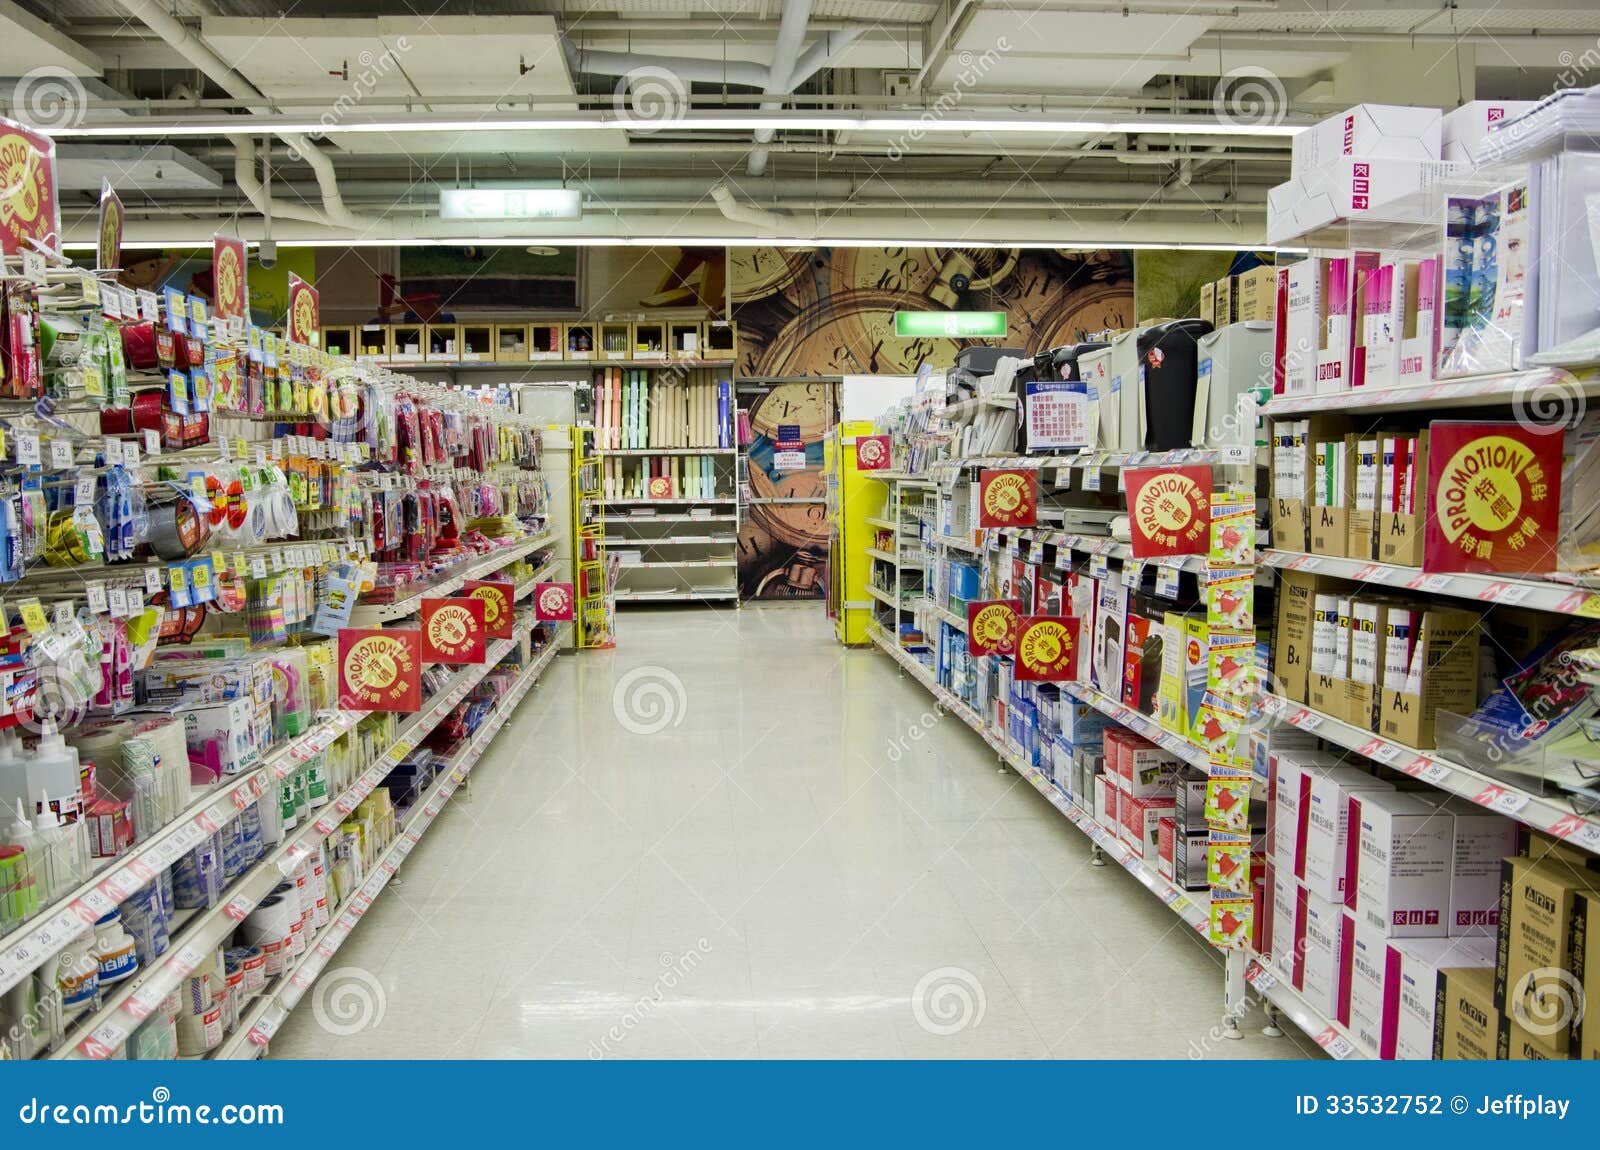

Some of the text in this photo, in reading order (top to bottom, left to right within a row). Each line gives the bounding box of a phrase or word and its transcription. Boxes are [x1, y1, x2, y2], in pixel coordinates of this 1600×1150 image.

[23, 441, 32, 452] 39
[1229, 449, 1242, 457] 69
[987, 477, 1020, 510] PROMOTION
[1446, 446, 1524, 531] PROMOTION
[1474, 477, 1516, 522] 特價
[1140, 478, 1188, 531] PROMOTION
[1159, 497, 1188, 524] 特價
[1278, 498, 1291, 518] B4
[1320, 507, 1334, 528] A4
[1391, 513, 1406, 536] A4
[1459, 532, 1494, 560] 特價
[431, 608, 466, 645] PROMOTION
[976, 607, 1007, 640] PROMOTION
[1024, 625, 1061, 662] PROMOTION
[1287, 644, 1300, 665] B4
[350, 640, 397, 688] PROMOTION
[1393, 691, 1409, 714] A4
[1525, 885, 1556, 914] ART
[16, 948, 29, 962] 40
[1460, 997, 1488, 1028] ART
